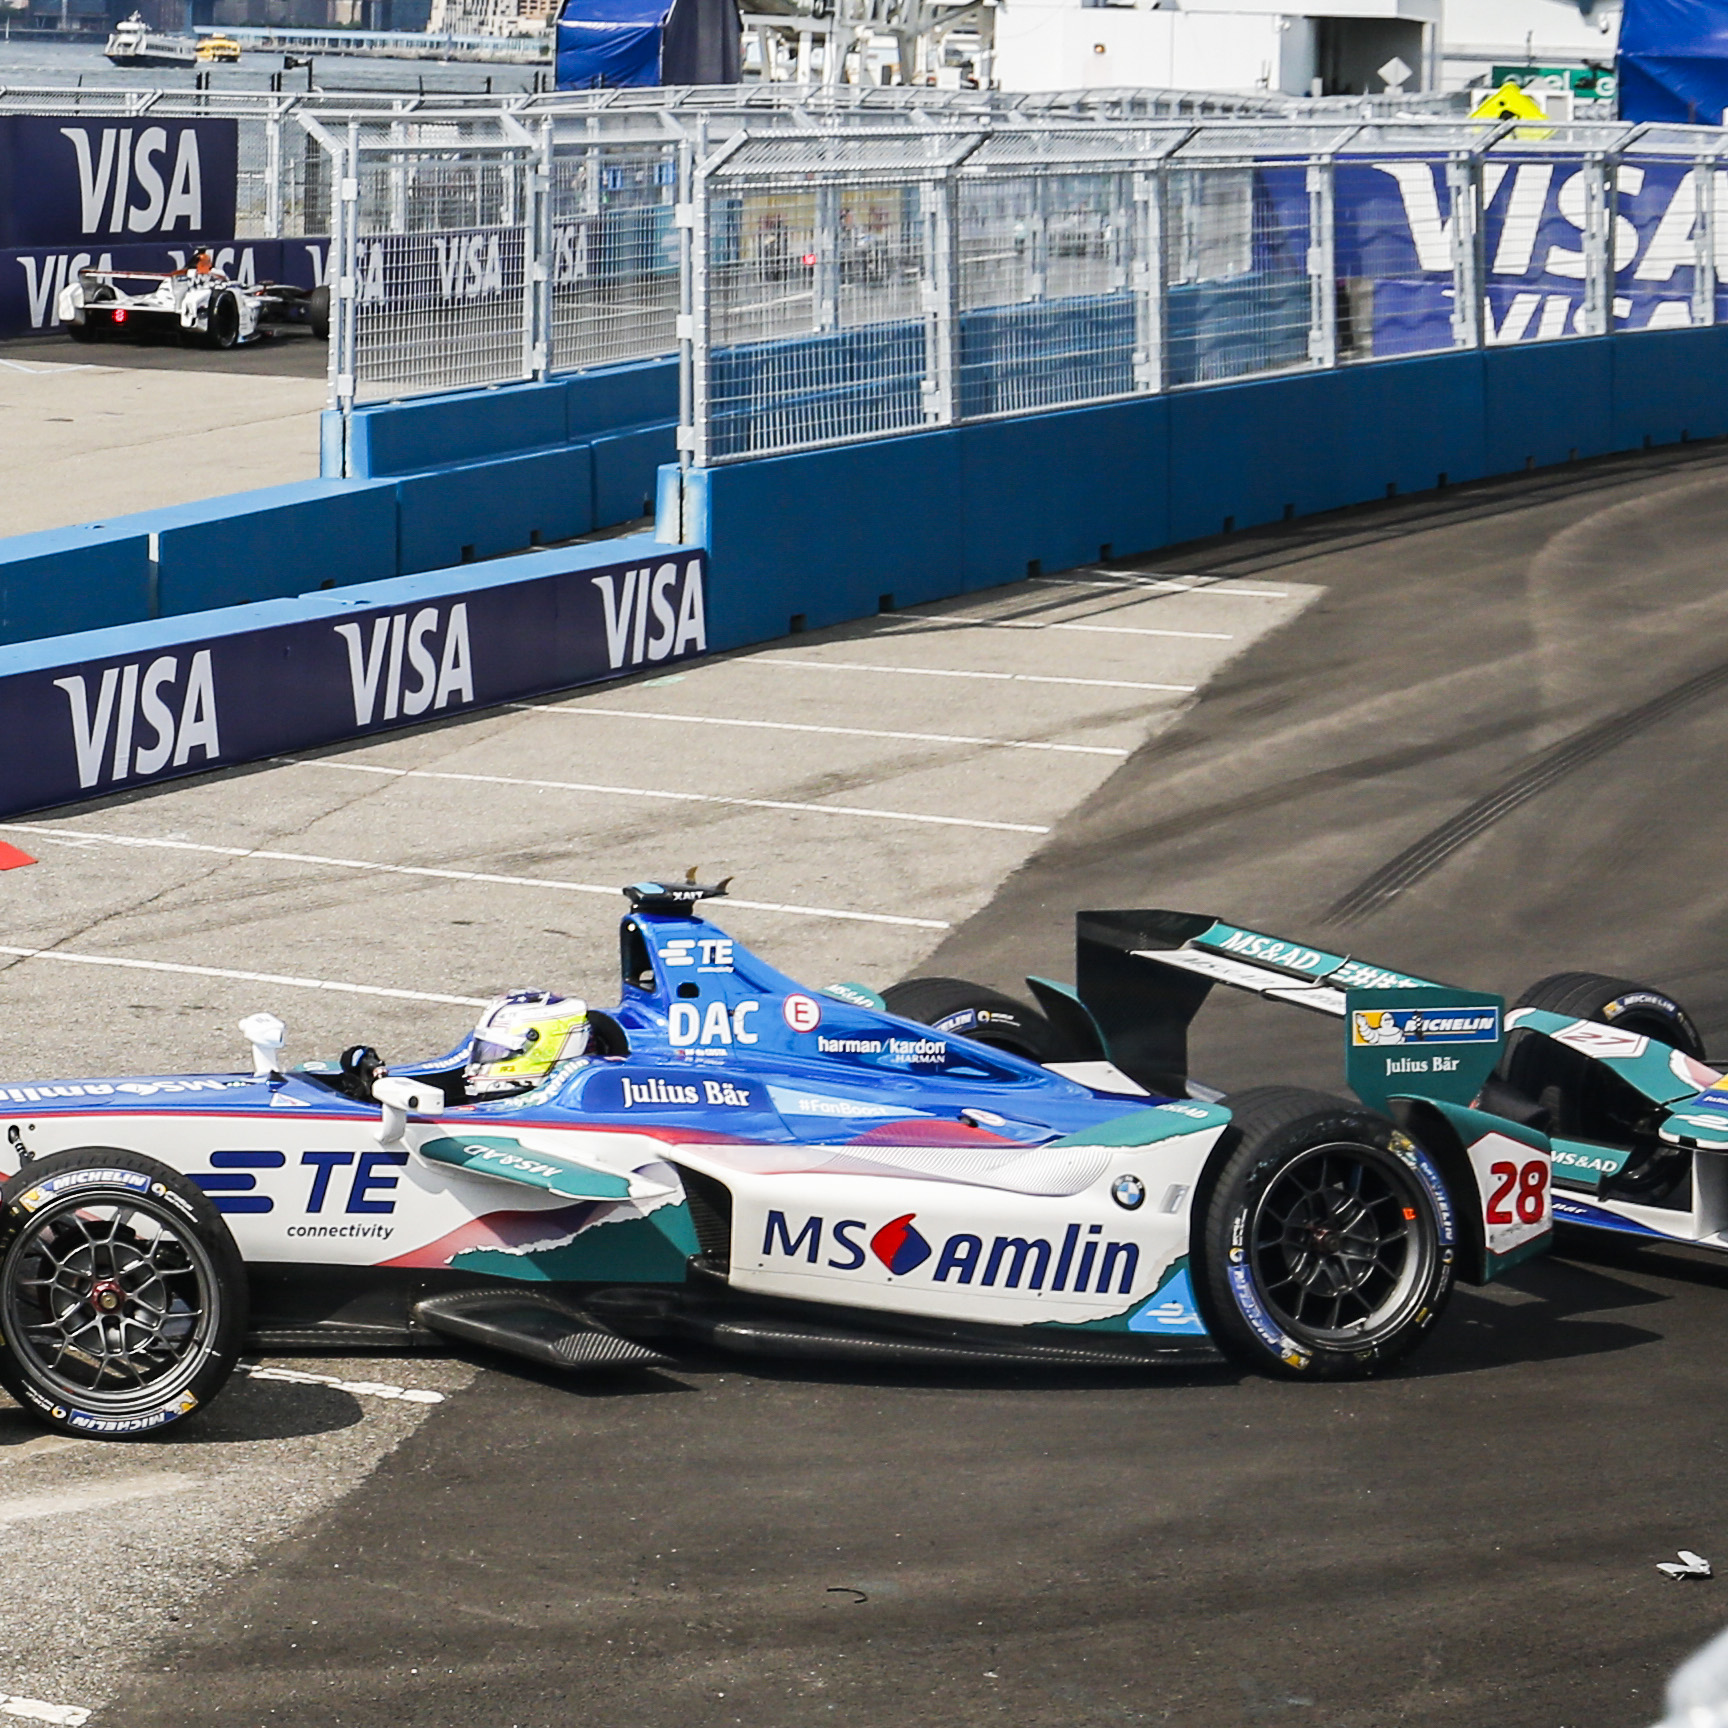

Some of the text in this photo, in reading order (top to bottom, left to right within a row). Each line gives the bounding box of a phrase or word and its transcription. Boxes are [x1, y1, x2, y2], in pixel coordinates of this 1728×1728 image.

[60, 126, 202, 234] VISA
[1373, 163, 1728, 282] VISA
[432, 232, 502, 302] VISA
[592, 559, 707, 668] VISA
[335, 602, 474, 726] VISA
[53, 649, 221, 788] VISA
[673, 891, 704, 901] XAIT
[1219, 930, 1322, 971] MS&AD
[1624, 994, 1675, 1012] MICHELIN
[669, 1001, 760, 1046] DAC
[1404, 1014, 1495, 1031] MICHELIN
[818, 1036, 947, 1055] harman/kardon
[1562, 1032, 1635, 1046] 27
[896, 1055, 946, 1063] HARMAN
[1386, 1055, 1461, 1075] Julius Bär
[621, 1078, 750, 1108] Julius Bär
[798, 1099, 887, 1117] #FanBoost
[462, 1144, 563, 1178] MS&AD
[1551, 1150, 1618, 1173] MS&AD
[53, 1170, 146, 1191] MICHELIN
[1485, 1159, 1547, 1225] 28
[286, 1223, 395, 1241] connectivity
[761, 1209, 1140, 1295] MS Amlin
[72, 1412, 166, 1431] MICHELIN
